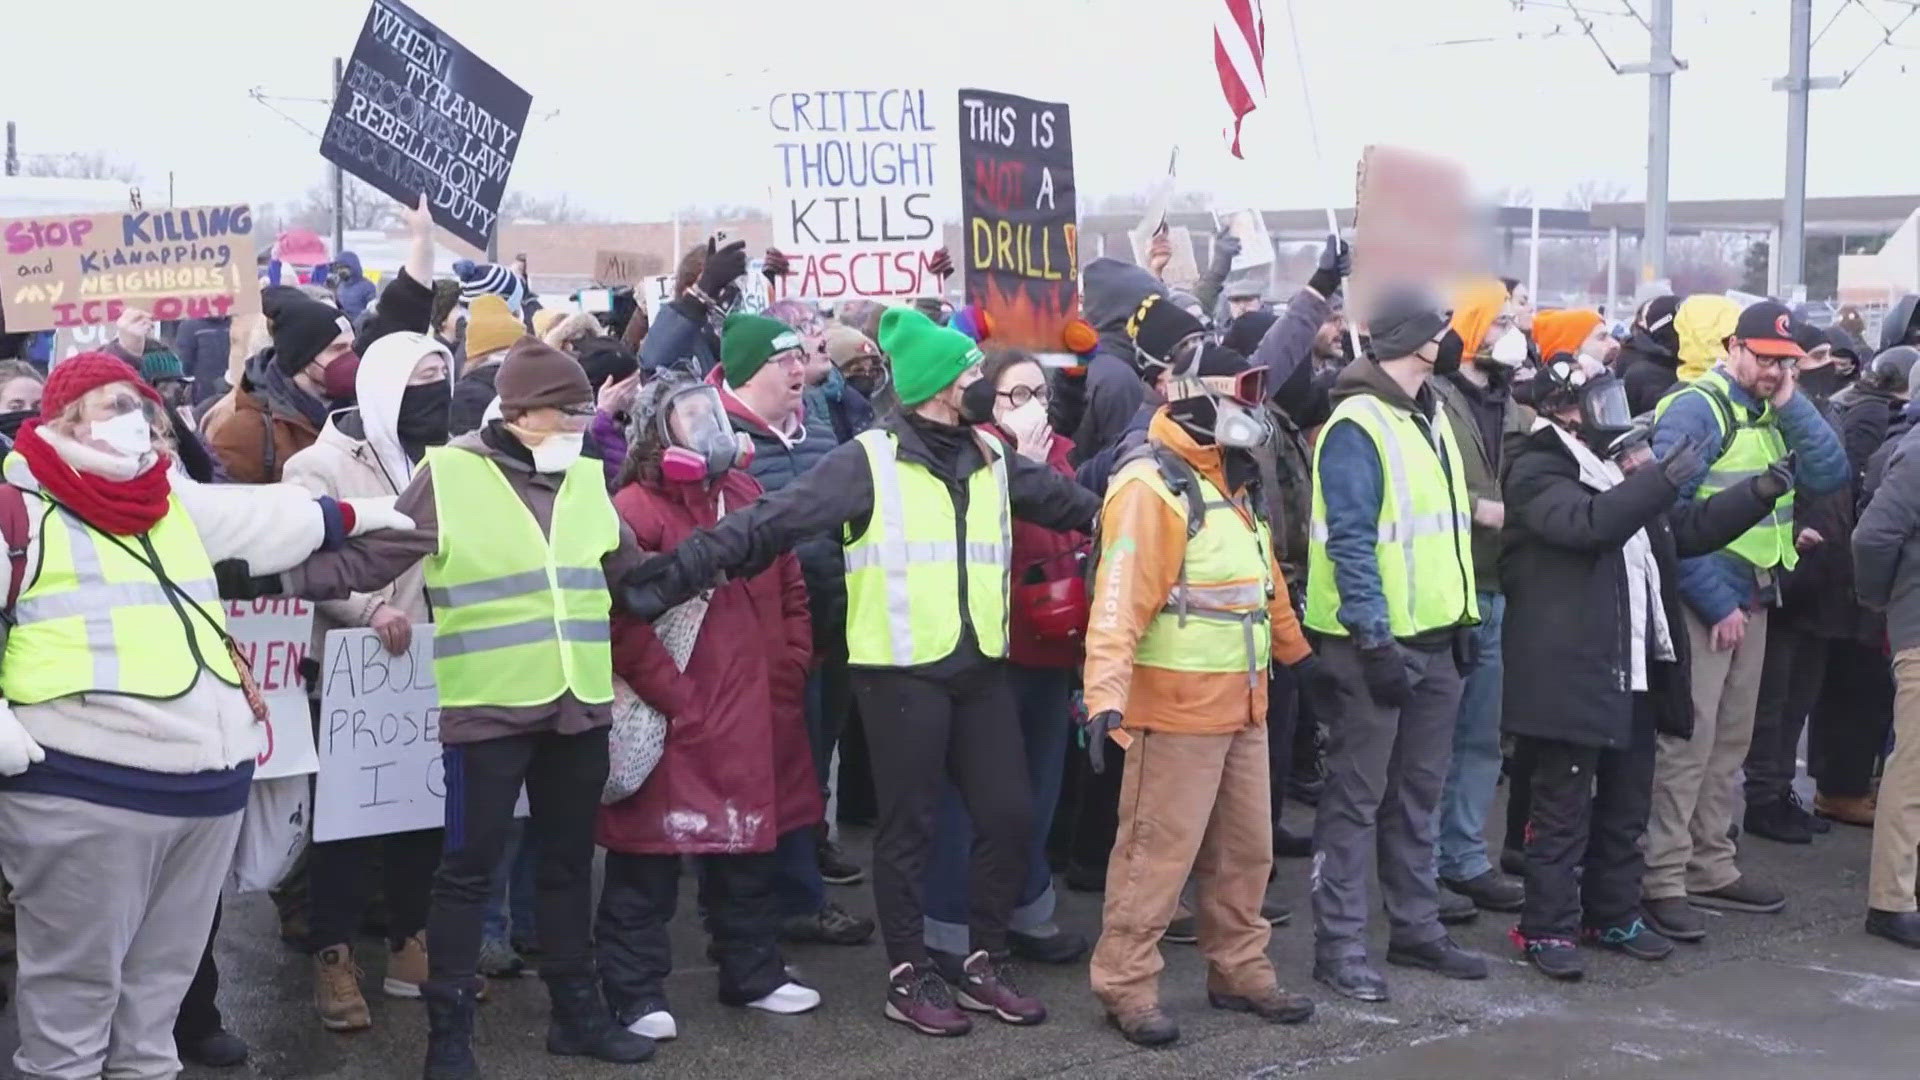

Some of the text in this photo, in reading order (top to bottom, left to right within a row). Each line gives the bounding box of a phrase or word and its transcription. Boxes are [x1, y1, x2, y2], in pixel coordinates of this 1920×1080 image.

[372, 3, 447, 76] WHEN
[405, 61, 517, 154] TYRANNY
[769, 89, 936, 132] CRITICAL
[963, 99, 1055, 148] THIS IS
[459, 132, 511, 183] LAW
[774, 140, 937, 188] THOUGHT
[434, 178, 497, 237] DUTY
[974, 157, 1055, 212] NOT A
[123, 206, 253, 246] KILLING
[791, 193, 934, 244] KILLS
[17, 257, 53, 277] and
[782, 250, 943, 298] FASCISM
[972, 217, 1077, 282] DRILL!
[153, 295, 234, 321] OUT
